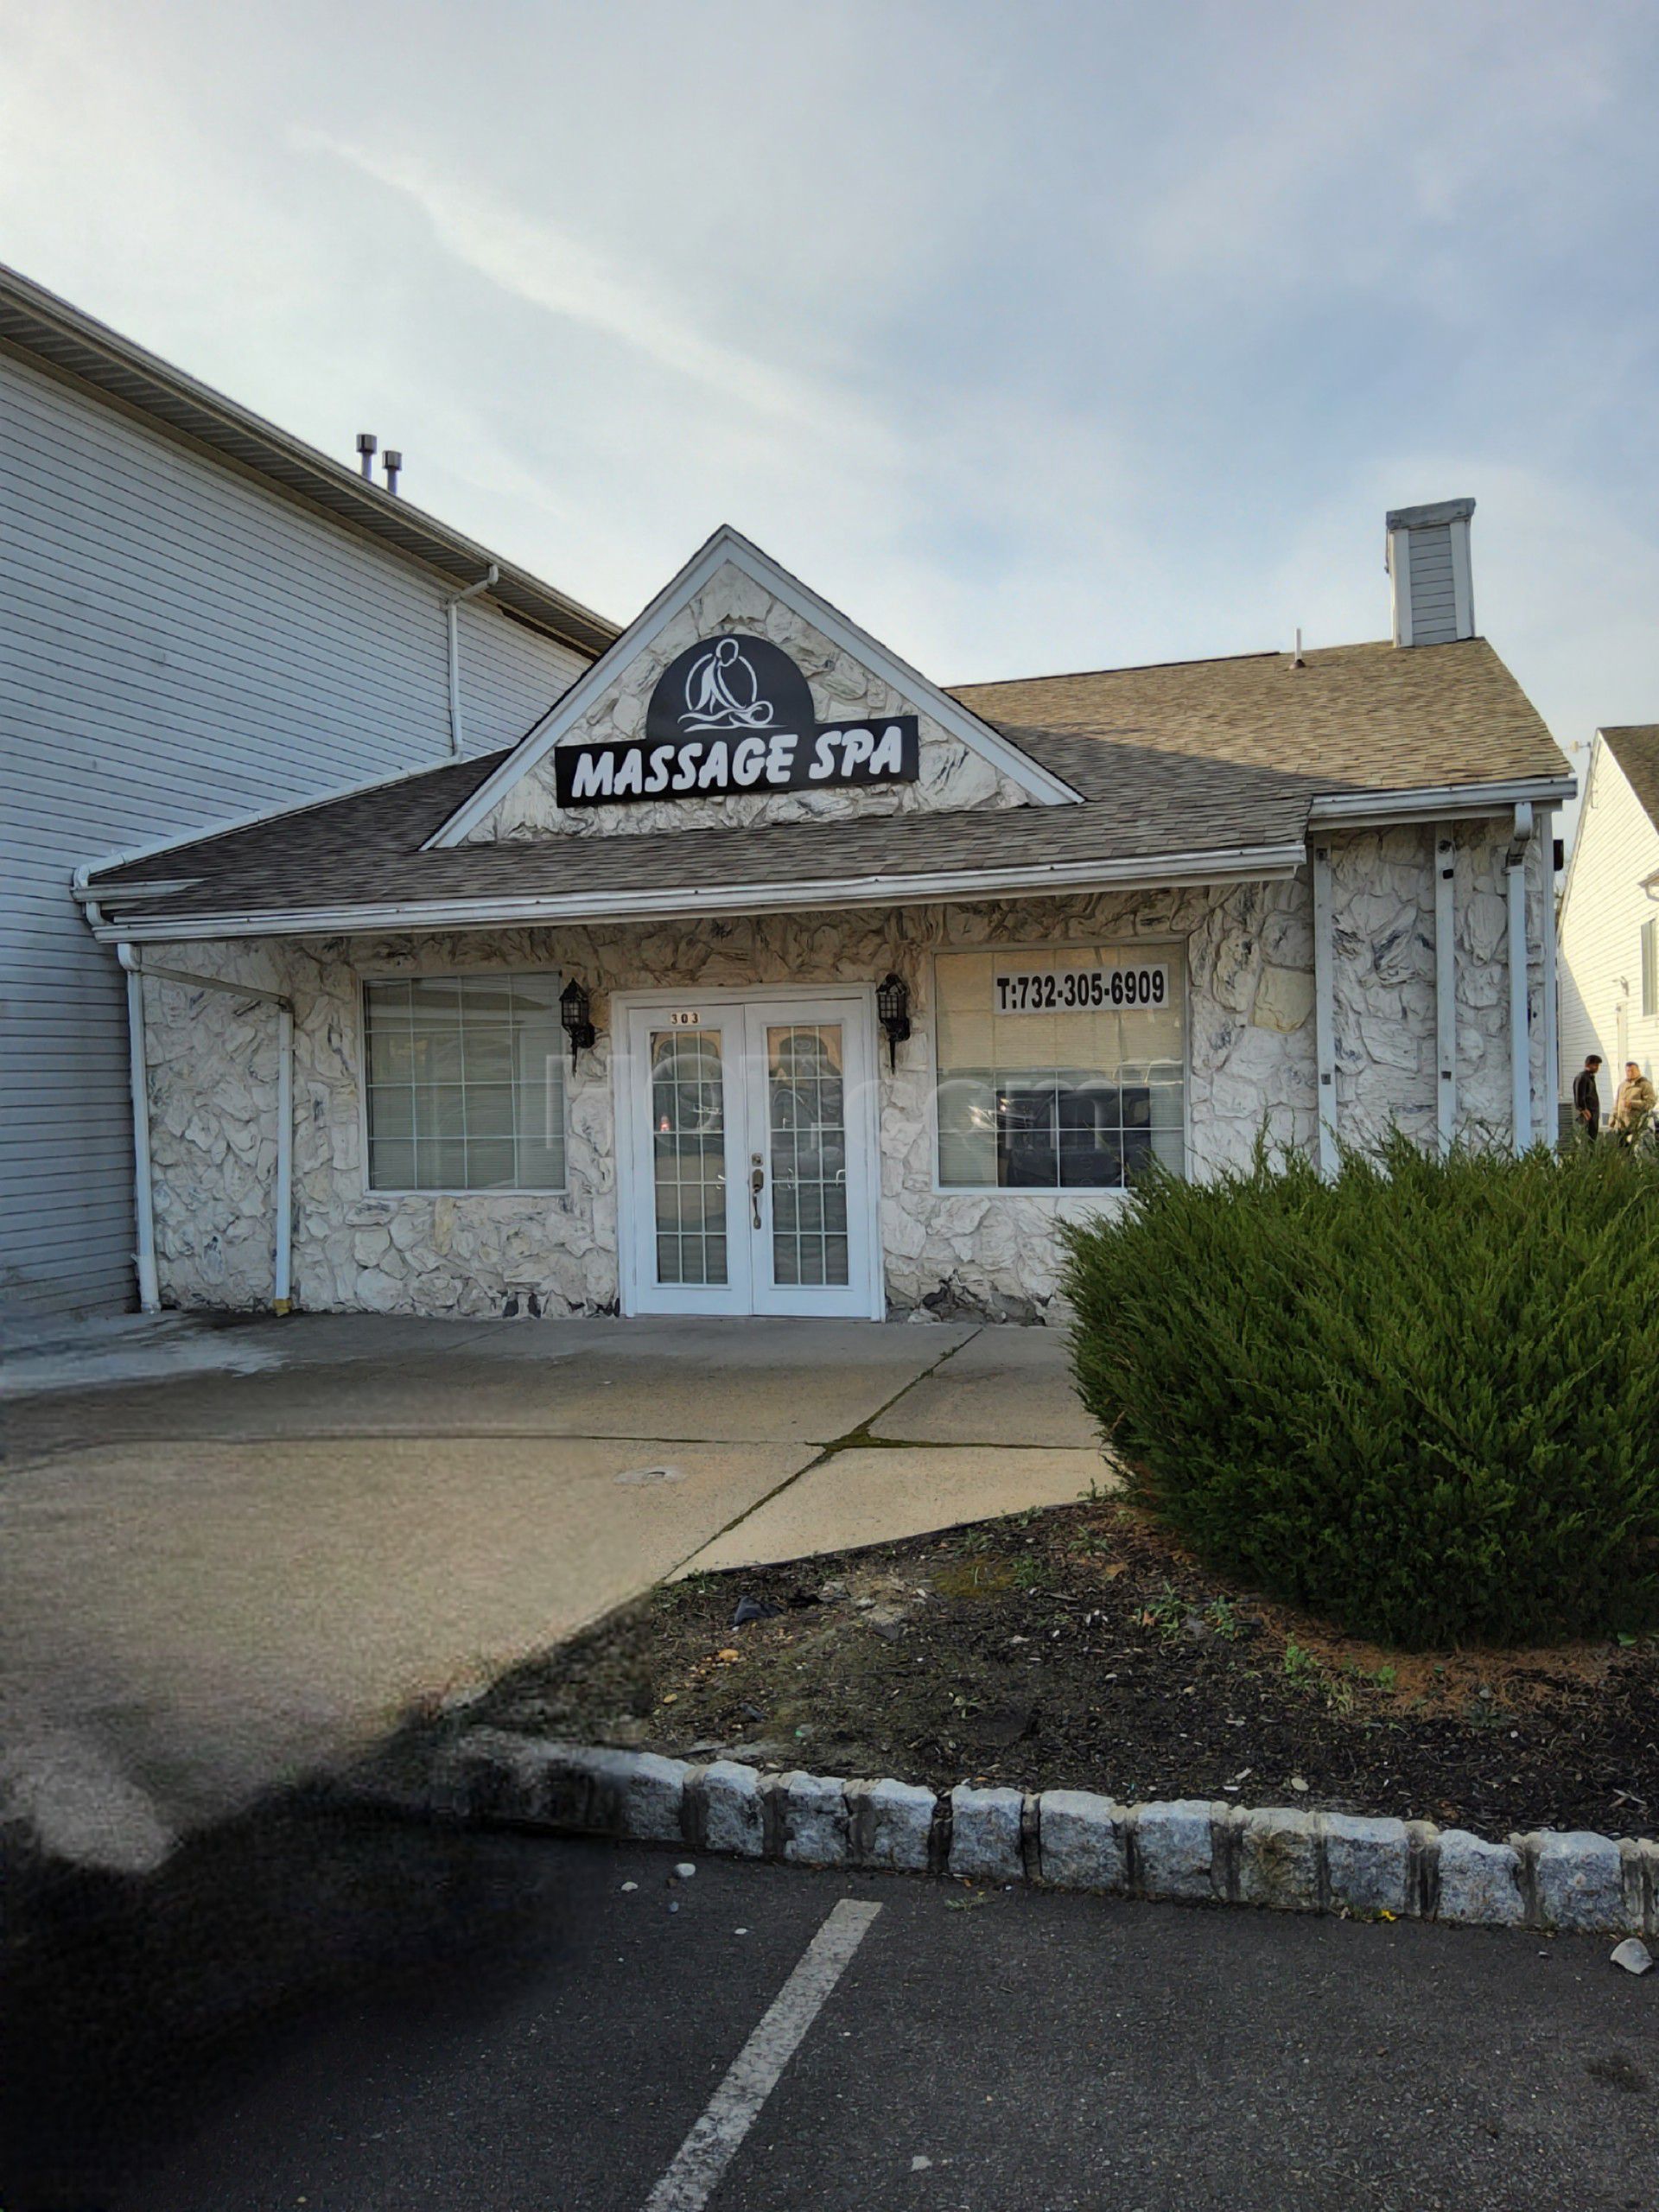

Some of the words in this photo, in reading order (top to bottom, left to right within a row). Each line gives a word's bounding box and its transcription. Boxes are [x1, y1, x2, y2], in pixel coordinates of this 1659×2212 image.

[571, 734, 798, 798] MASSAGE
[809, 727, 902, 779] SPA
[997, 969, 1165, 1009] T:732-305-6909
[671, 1013, 698, 1025] 303
